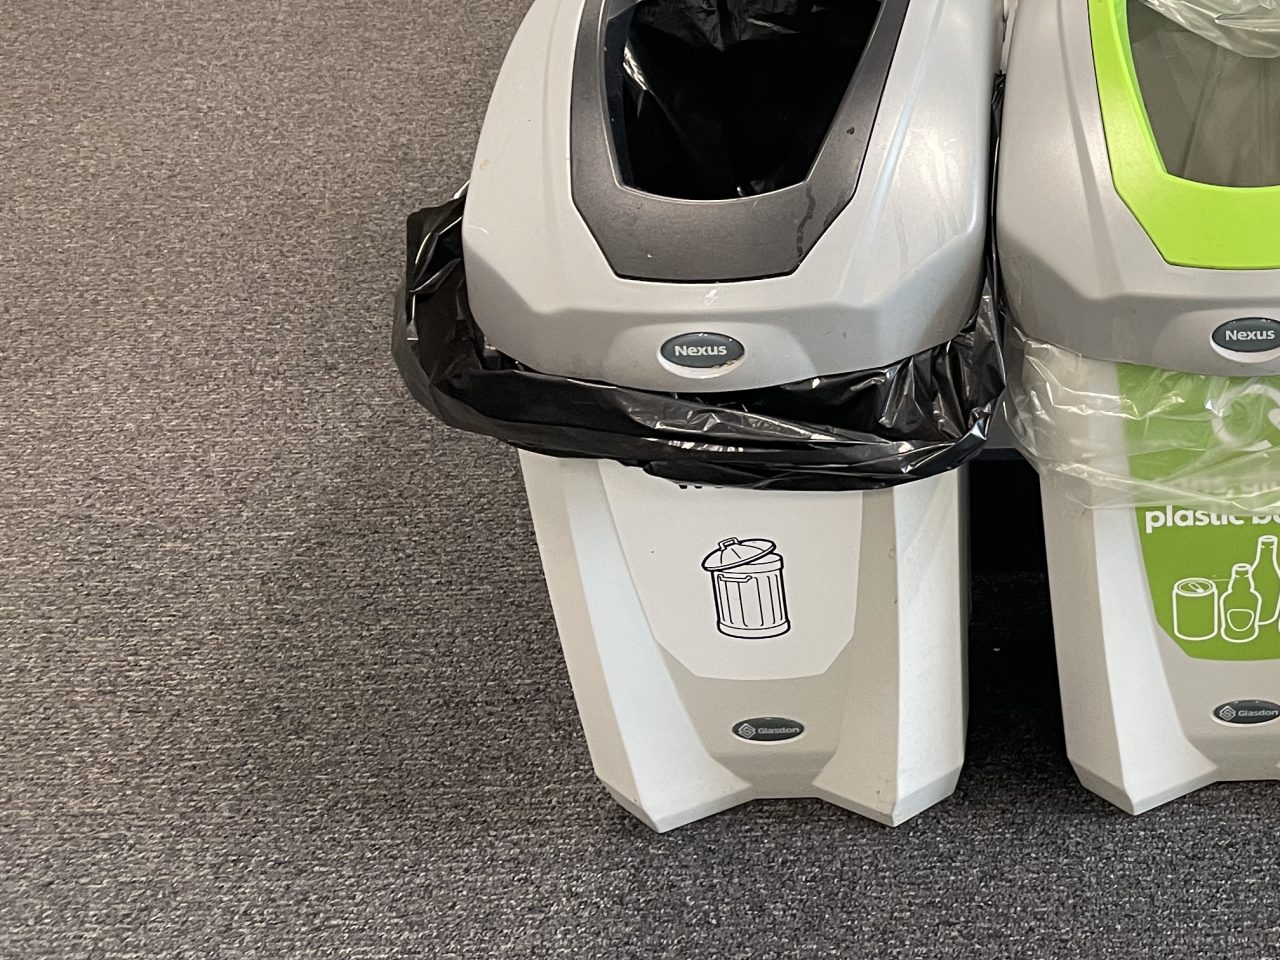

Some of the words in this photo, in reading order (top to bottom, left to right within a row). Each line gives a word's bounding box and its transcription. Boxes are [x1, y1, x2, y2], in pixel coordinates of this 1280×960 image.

[1225, 329, 1276, 341] Nexus
[674, 344, 728, 356] Nexus
[1237, 708, 1279, 717] Glasdon
[758, 726, 800, 735] Glasdon
